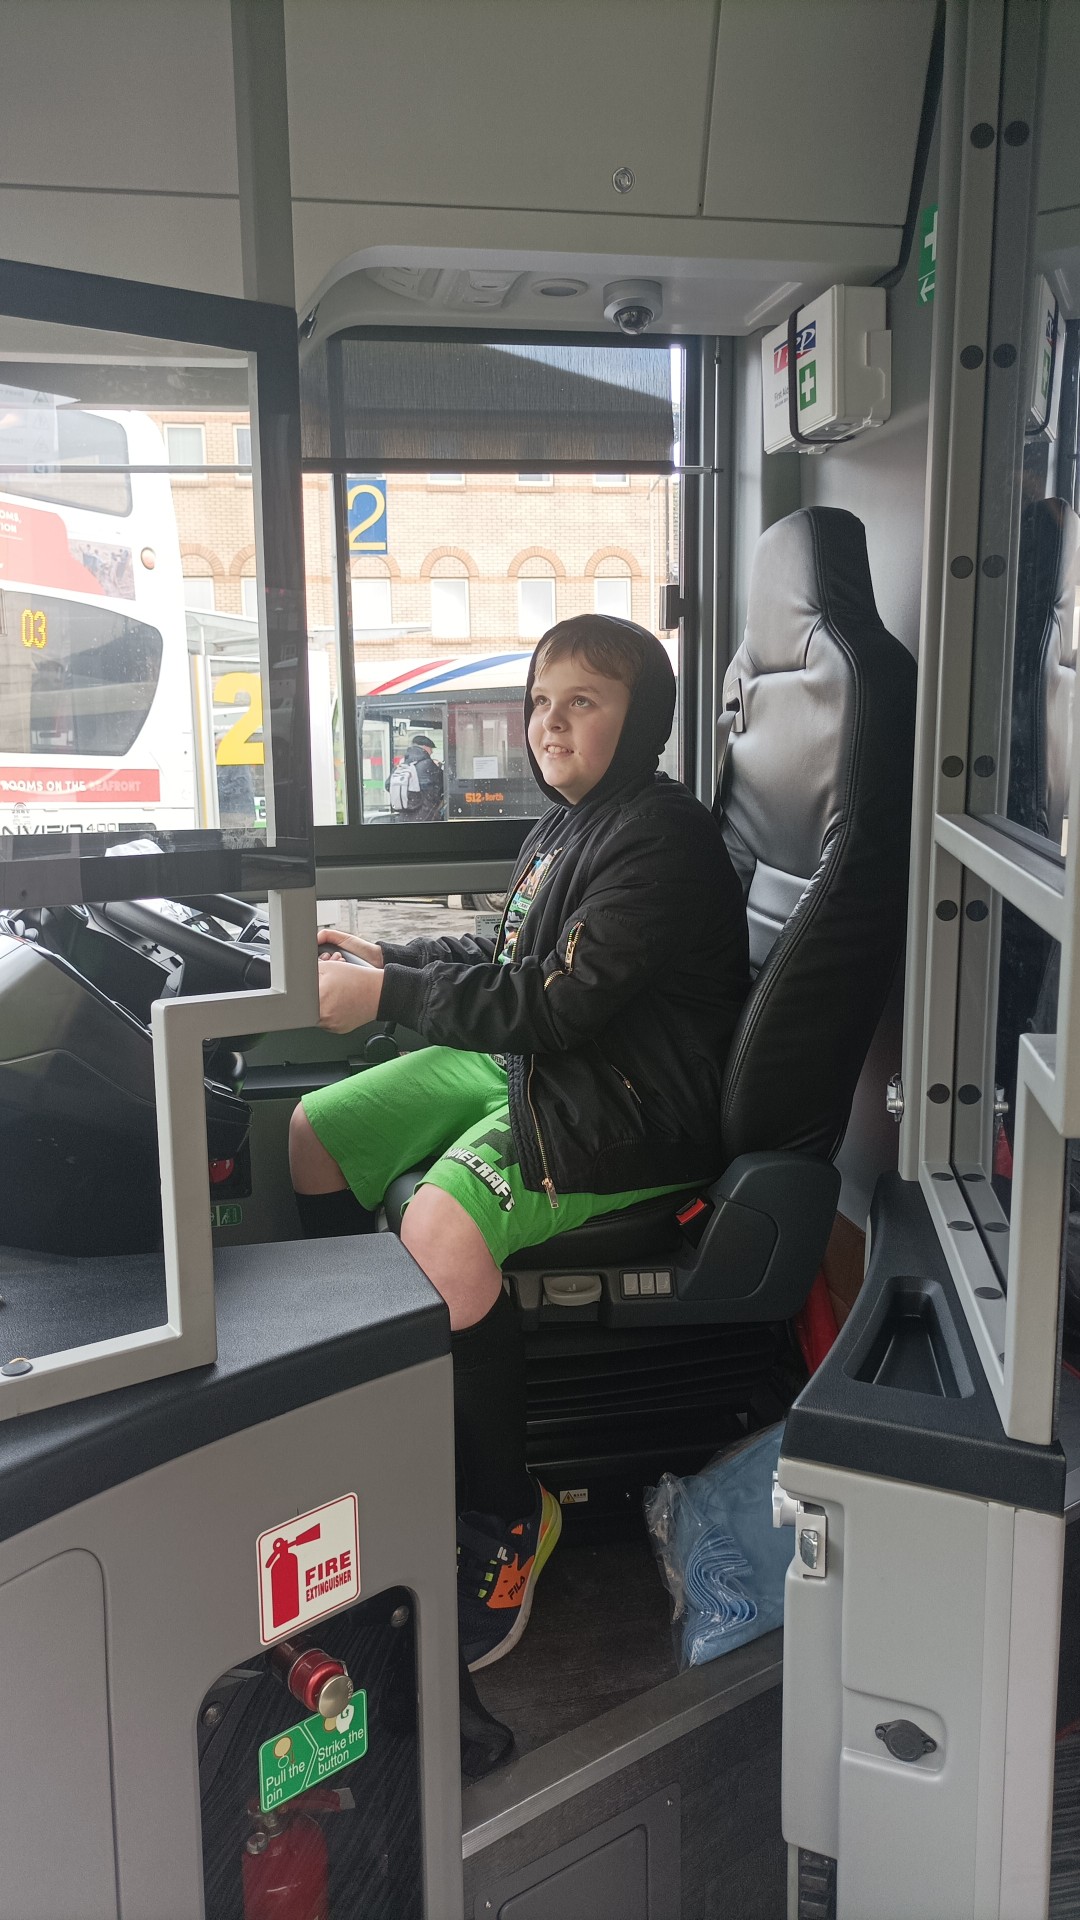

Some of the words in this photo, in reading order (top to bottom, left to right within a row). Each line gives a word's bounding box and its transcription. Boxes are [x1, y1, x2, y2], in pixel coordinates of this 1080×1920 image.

[347, 484, 386, 551] 2
[21, 609, 47, 649] 03
[213, 672, 264, 766] 2
[46, 781, 63, 792] ON
[65, 781, 86, 792] THE
[305, 1550, 351, 1587] FIRE
[306, 1569, 352, 1602] EXTINGUISHER
[508, 1576, 525, 1600] FILA
[317, 1738, 347, 1762] Strike
[348, 1728, 364, 1745] the
[266, 1768, 287, 1792] Pull
[288, 1762, 306, 1778] the
[318, 1750, 350, 1775] button
[267, 1788, 283, 1808] pin
